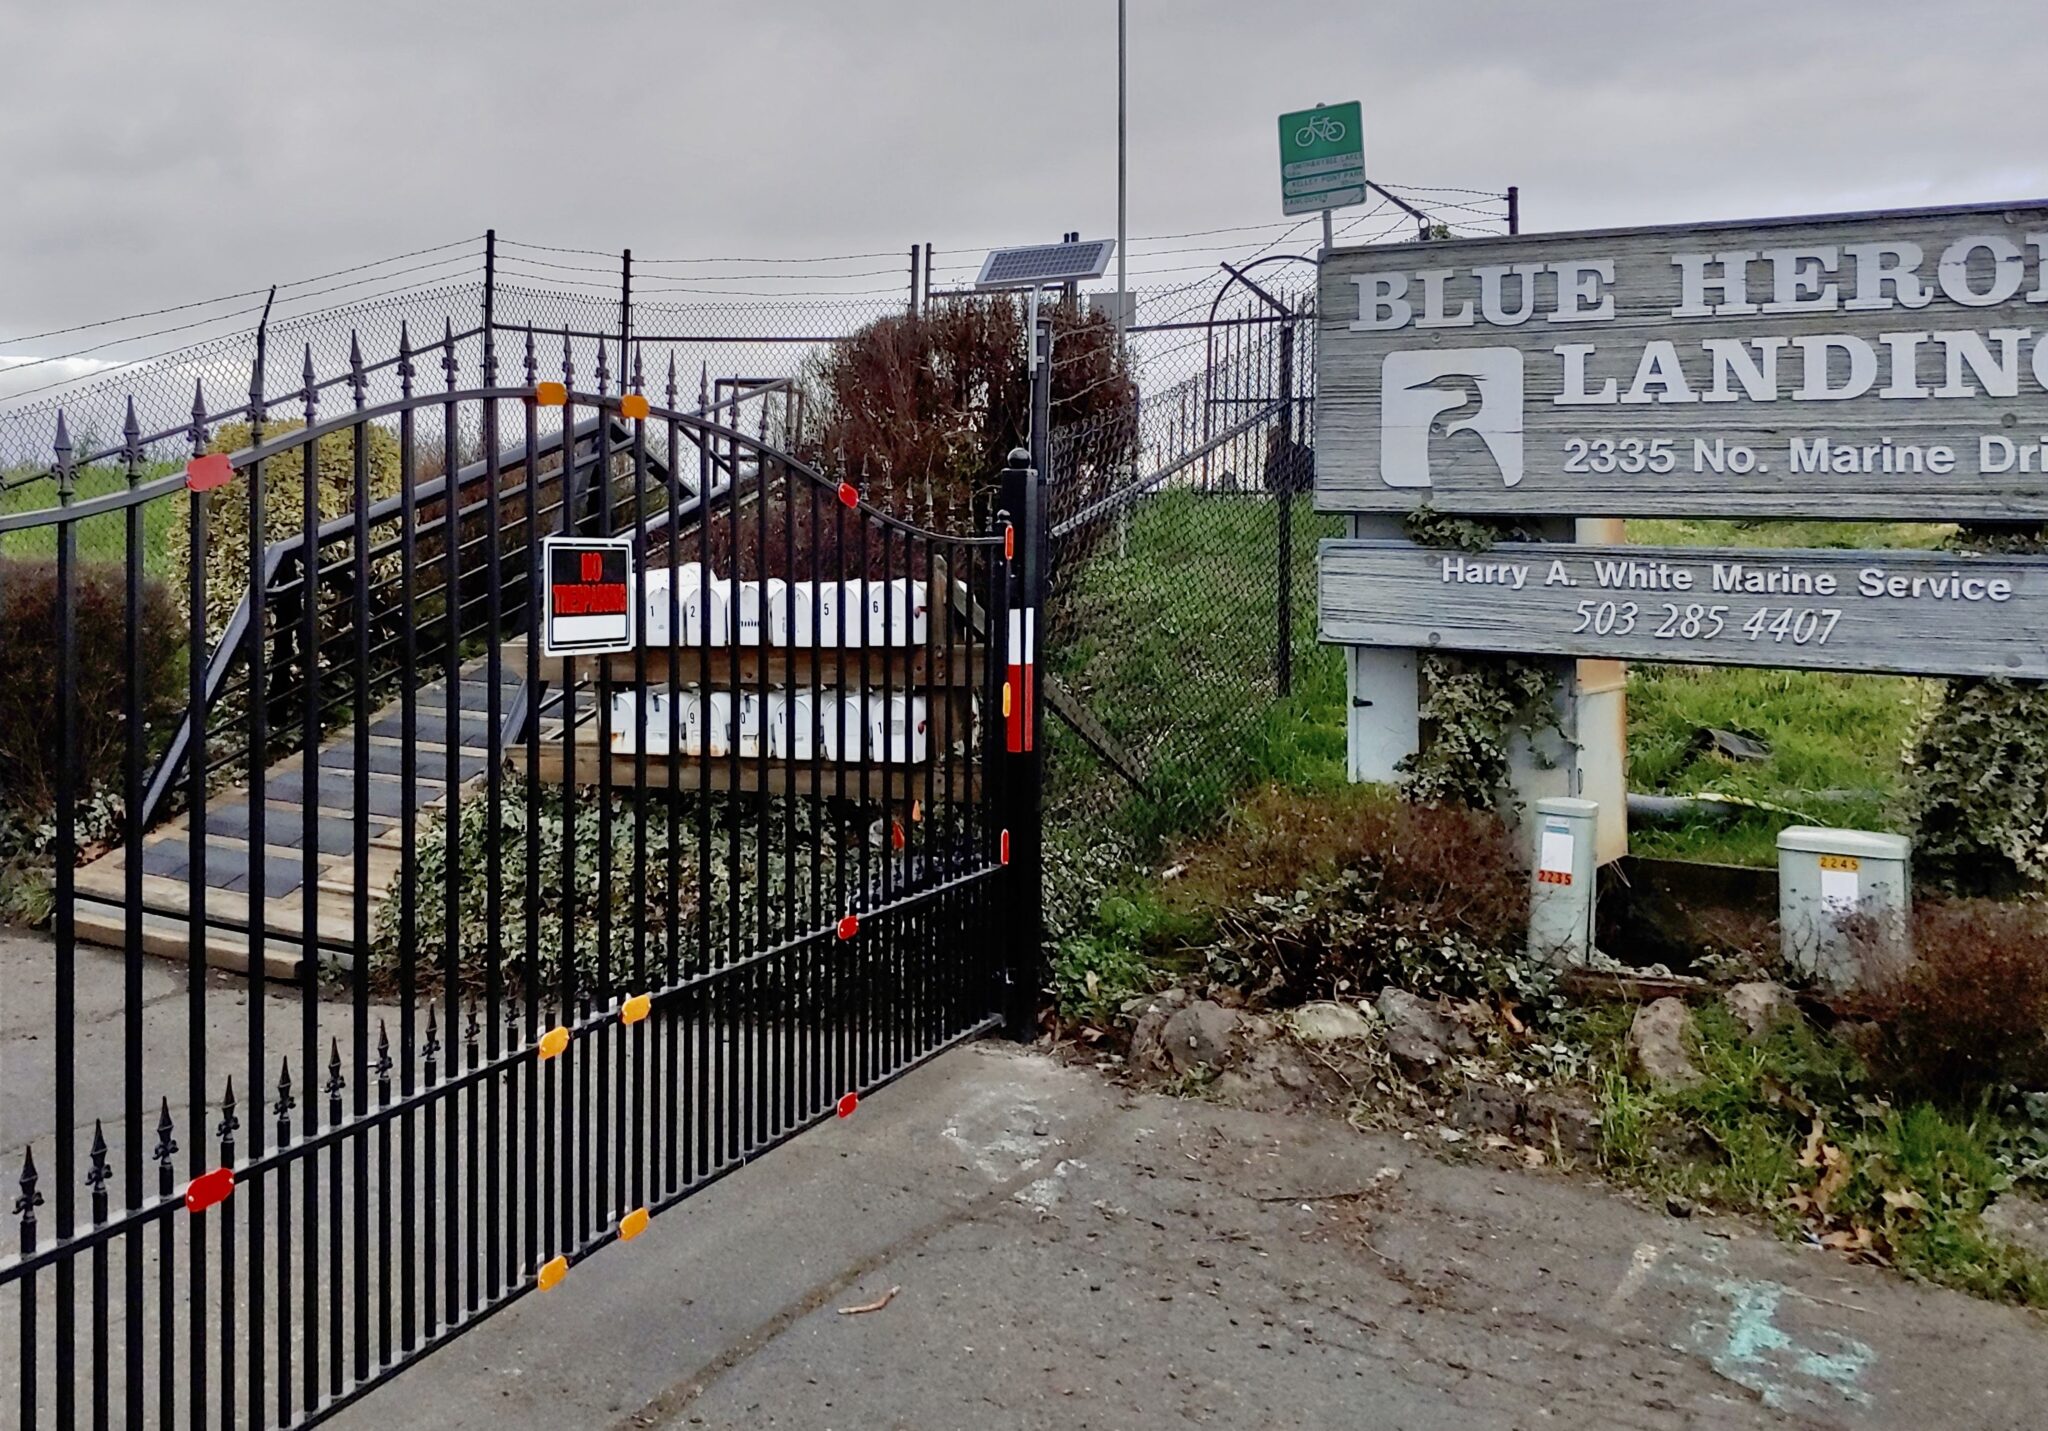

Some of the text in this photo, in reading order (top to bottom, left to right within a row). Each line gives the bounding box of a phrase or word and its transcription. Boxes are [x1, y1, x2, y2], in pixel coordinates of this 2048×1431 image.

[1349, 232, 2048, 332] BLUE HERO
[1553, 327, 2048, 405] LANDIN
[1562, 436, 1677, 475] 2335
[1693, 437, 1769, 475] No.
[1789, 436, 1957, 474] Marine
[581, 552, 603, 583] NO
[1442, 557, 2012, 601] Harry A. White Marine Service
[690, 605, 696, 618] 2
[824, 602, 830, 616] 5
[872, 600, 879, 614] 6
[1572, 600, 1842, 645] 503 285 4407
[689, 712, 696, 724] 9
[1820, 856, 1858, 871] 2245
[1538, 870, 1572, 886] 2235
